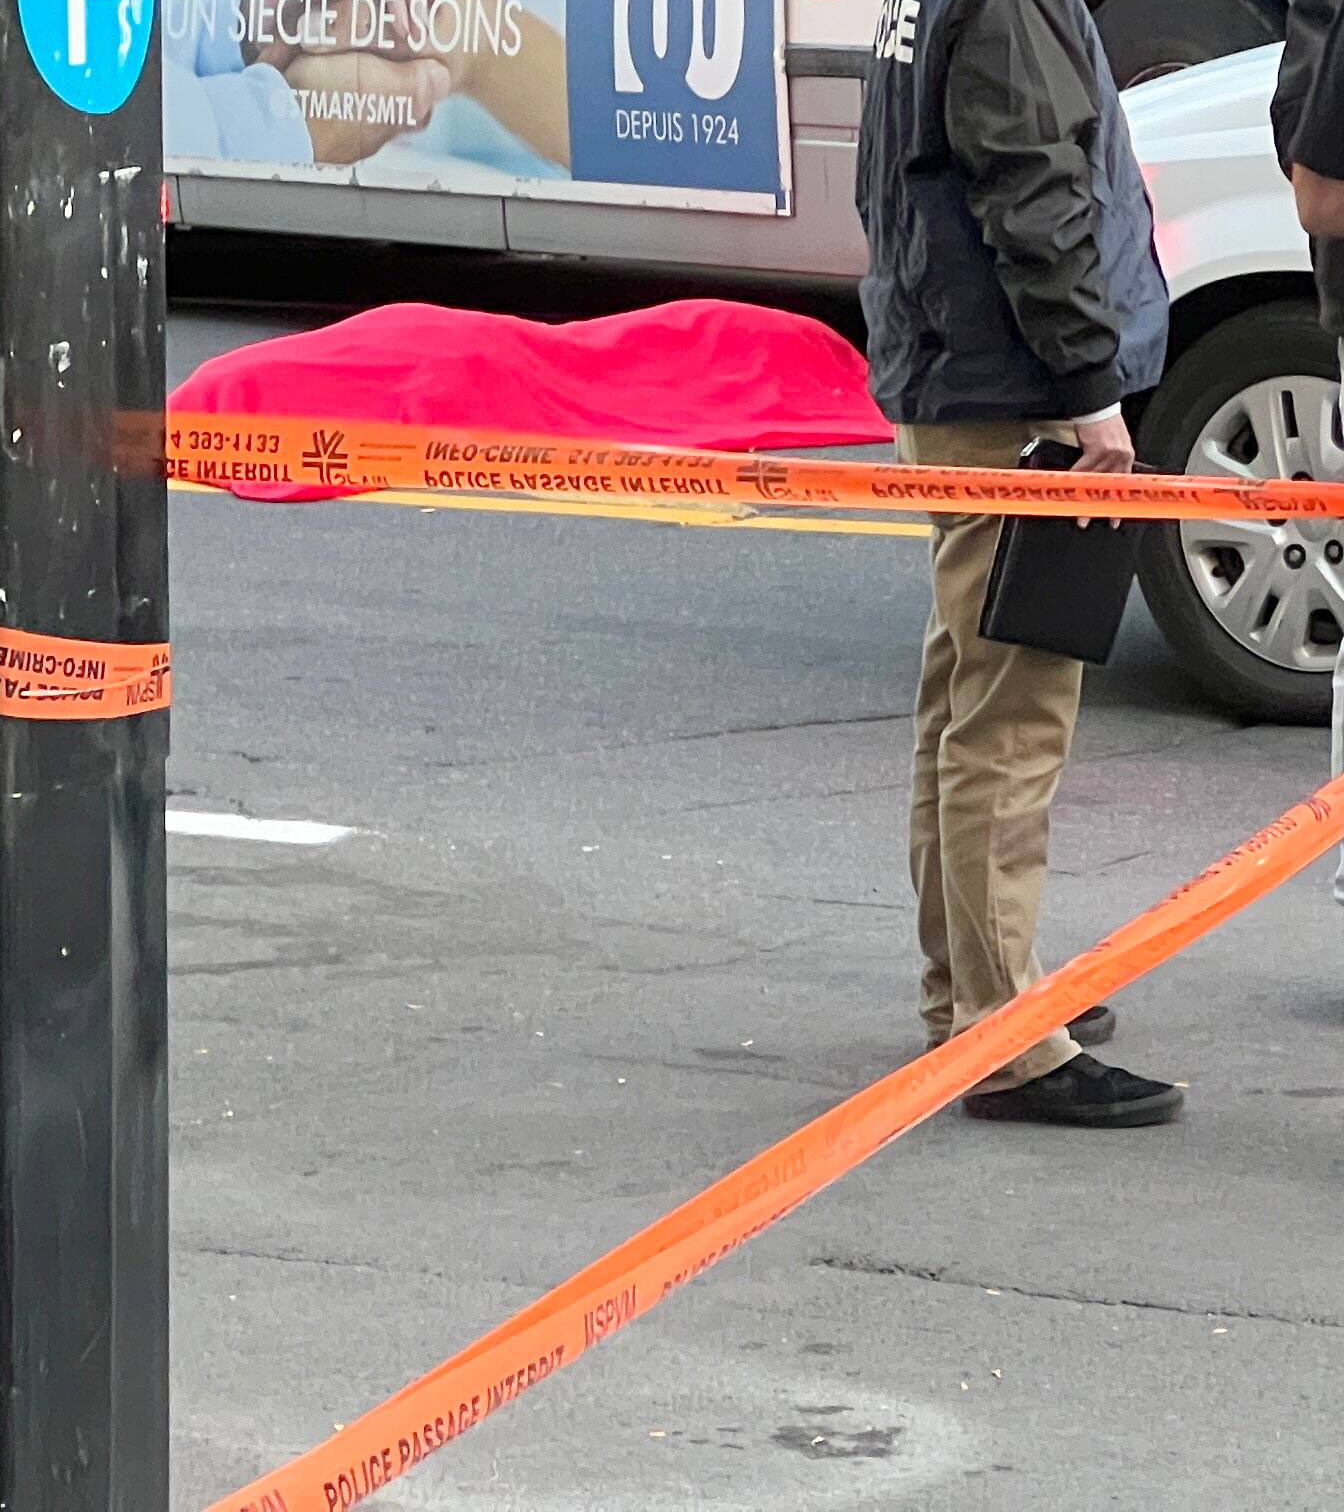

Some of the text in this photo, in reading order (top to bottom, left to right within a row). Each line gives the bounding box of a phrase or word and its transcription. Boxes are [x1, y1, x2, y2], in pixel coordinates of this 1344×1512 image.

[615, 109, 740, 146] DEPUIS 1924
[397, 1394, 481, 1477] PASSAGE
[486, 1344, 567, 1418] INTERDIT
